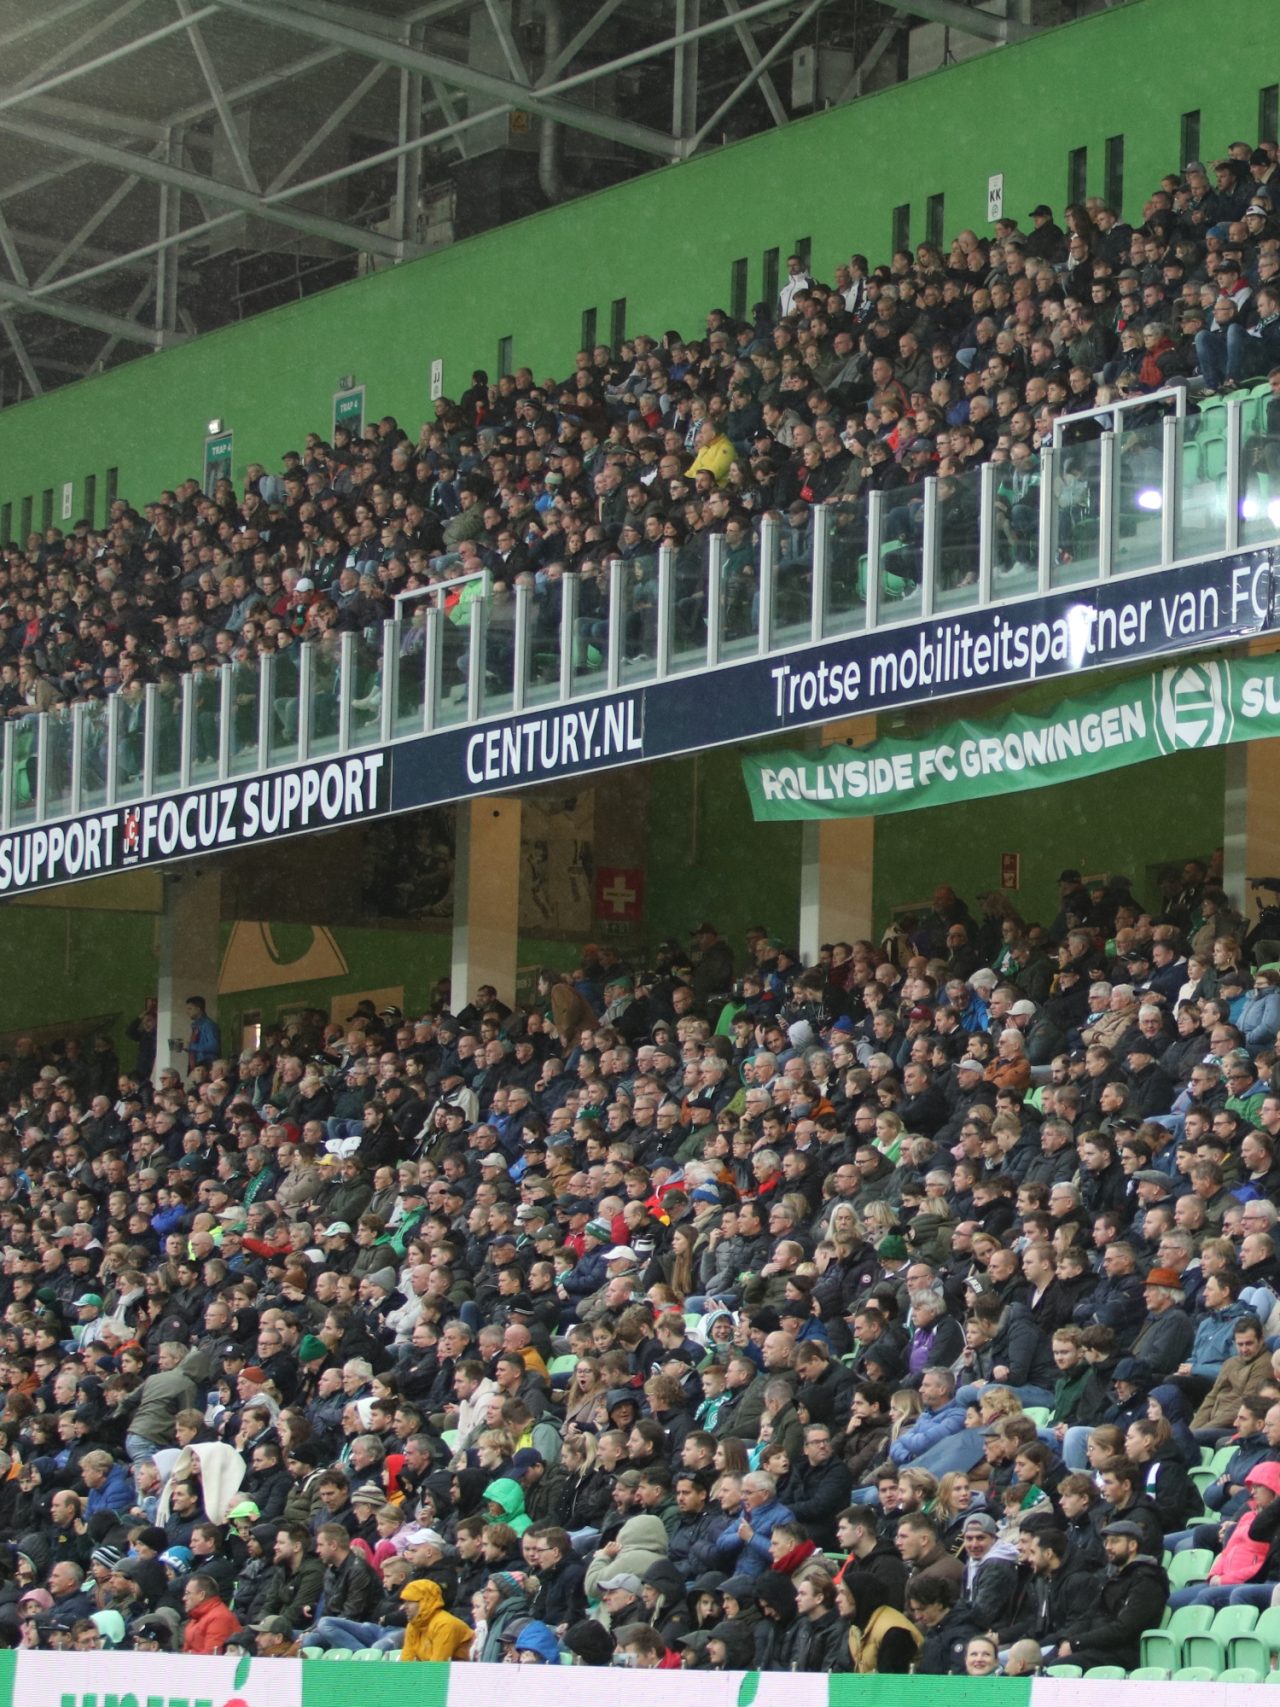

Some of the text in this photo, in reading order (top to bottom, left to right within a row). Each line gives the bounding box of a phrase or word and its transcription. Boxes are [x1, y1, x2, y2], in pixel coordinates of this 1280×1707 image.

[989, 188, 1001, 203] KK
[771, 661, 860, 717] Trotse
[870, 599, 1153, 695] mobiliteitspatner
[1160, 586, 1218, 639] van
[1231, 561, 1270, 624] FC
[466, 699, 643, 784] CENTURY.NL
[761, 702, 1147, 801] ROLLYSIDE FC GRONINGEN
[0, 813, 118, 890] SUPPORT
[142, 753, 384, 858] FOCUZ SUPPORT
